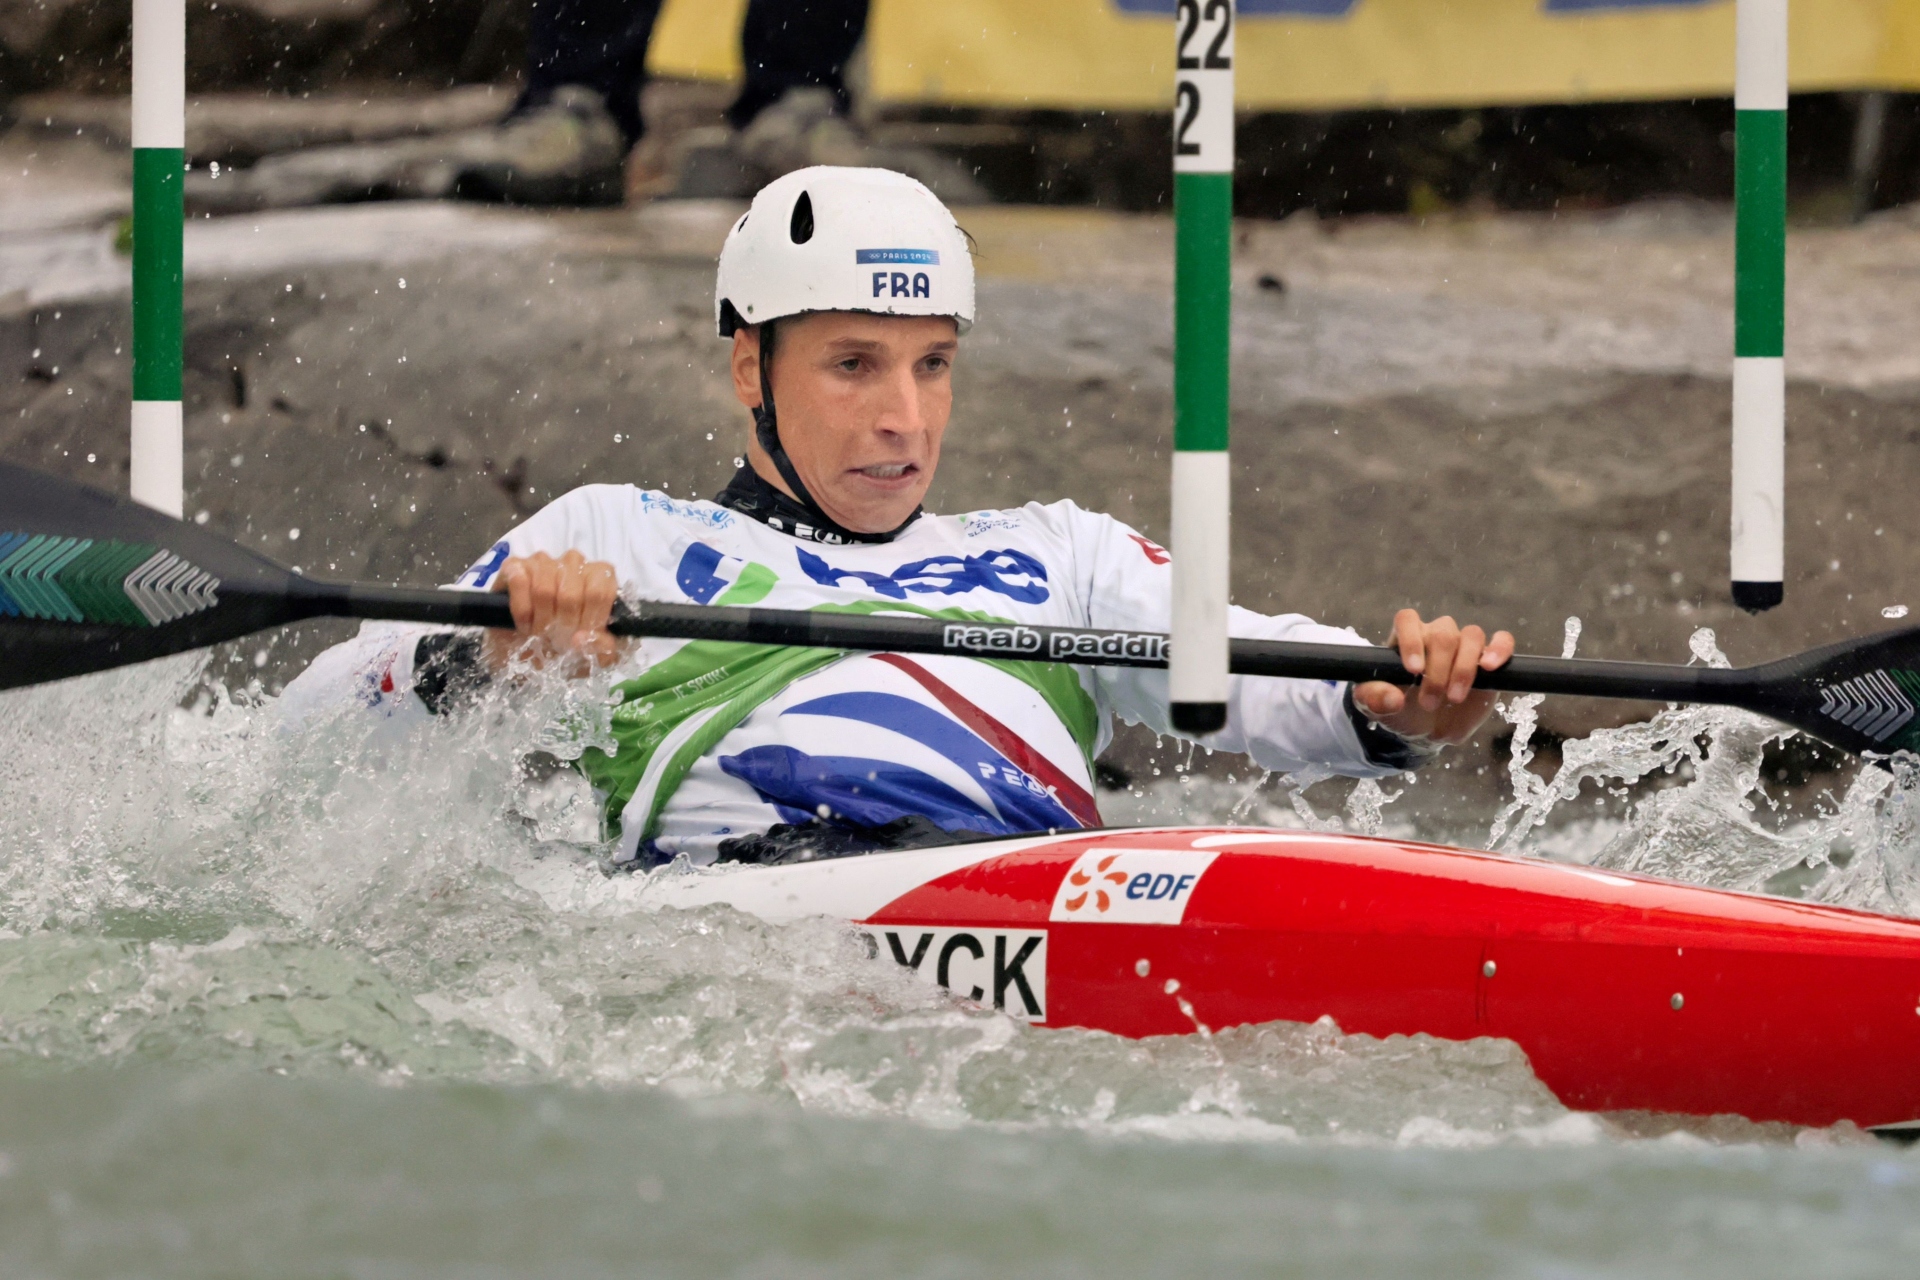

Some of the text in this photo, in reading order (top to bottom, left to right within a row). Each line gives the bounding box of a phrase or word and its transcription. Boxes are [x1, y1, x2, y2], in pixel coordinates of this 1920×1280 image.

[1176, 0, 1232, 69] 22
[1176, 81, 1201, 155] 2
[882, 252, 931, 260] PARIS 2024
[872, 271, 930, 298] FRA
[768, 516, 863, 545] PEA
[944, 625, 1041, 652] raab
[862, 929, 1044, 1017] YCK
